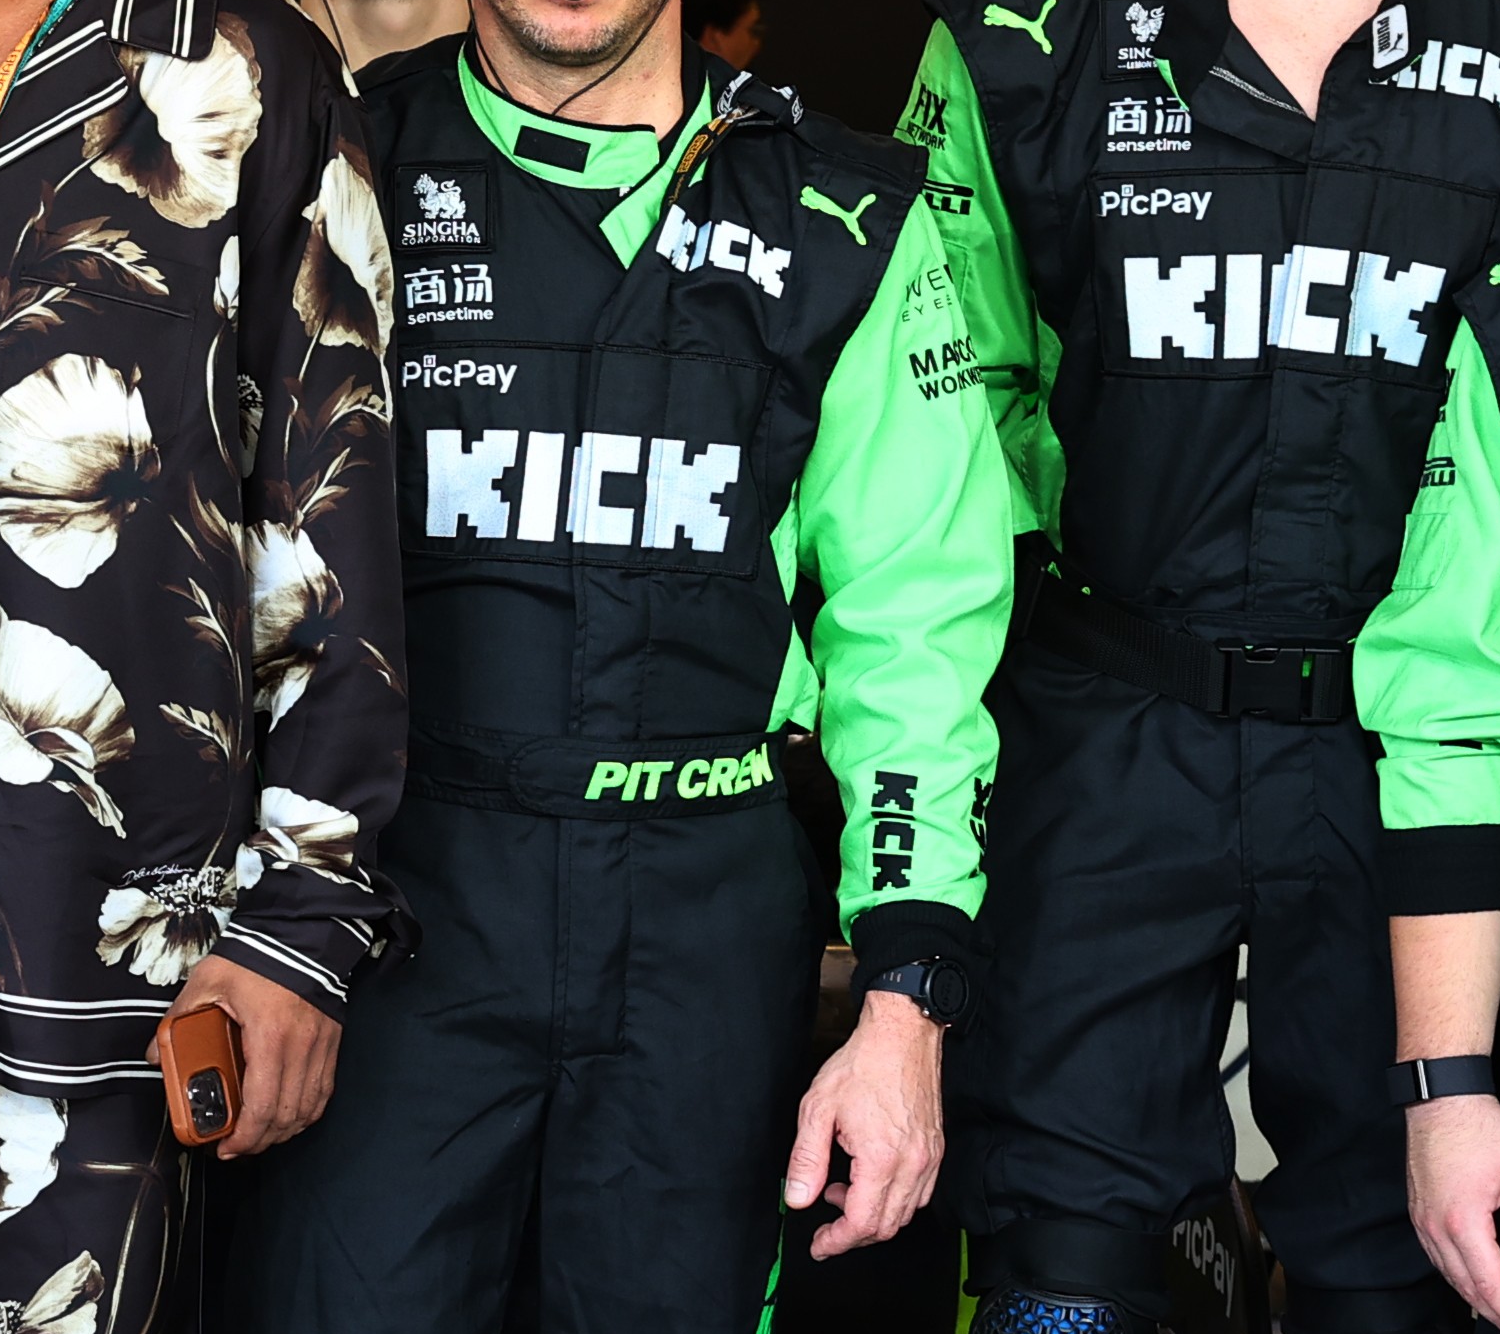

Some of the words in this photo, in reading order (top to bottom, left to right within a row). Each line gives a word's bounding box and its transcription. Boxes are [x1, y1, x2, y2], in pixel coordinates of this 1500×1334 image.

[911, 82, 948, 135] FIX
[908, 121, 947, 151] NETWORK
[1106, 137, 1193, 153] sensetime
[1099, 184, 1213, 220] PicPay
[402, 222, 480, 238] SINGHA
[655, 204, 791, 299] KICK
[404, 263, 493, 307] 商汤
[1124, 244, 1447, 367] KICK
[407, 307, 494, 324] sensetime
[402, 354, 517, 394] PicPay
[425, 430, 741, 552] KICK
[584, 762, 673, 801] PIT
[676, 743, 774, 800] CREW
[870, 771, 919, 892] KICK
